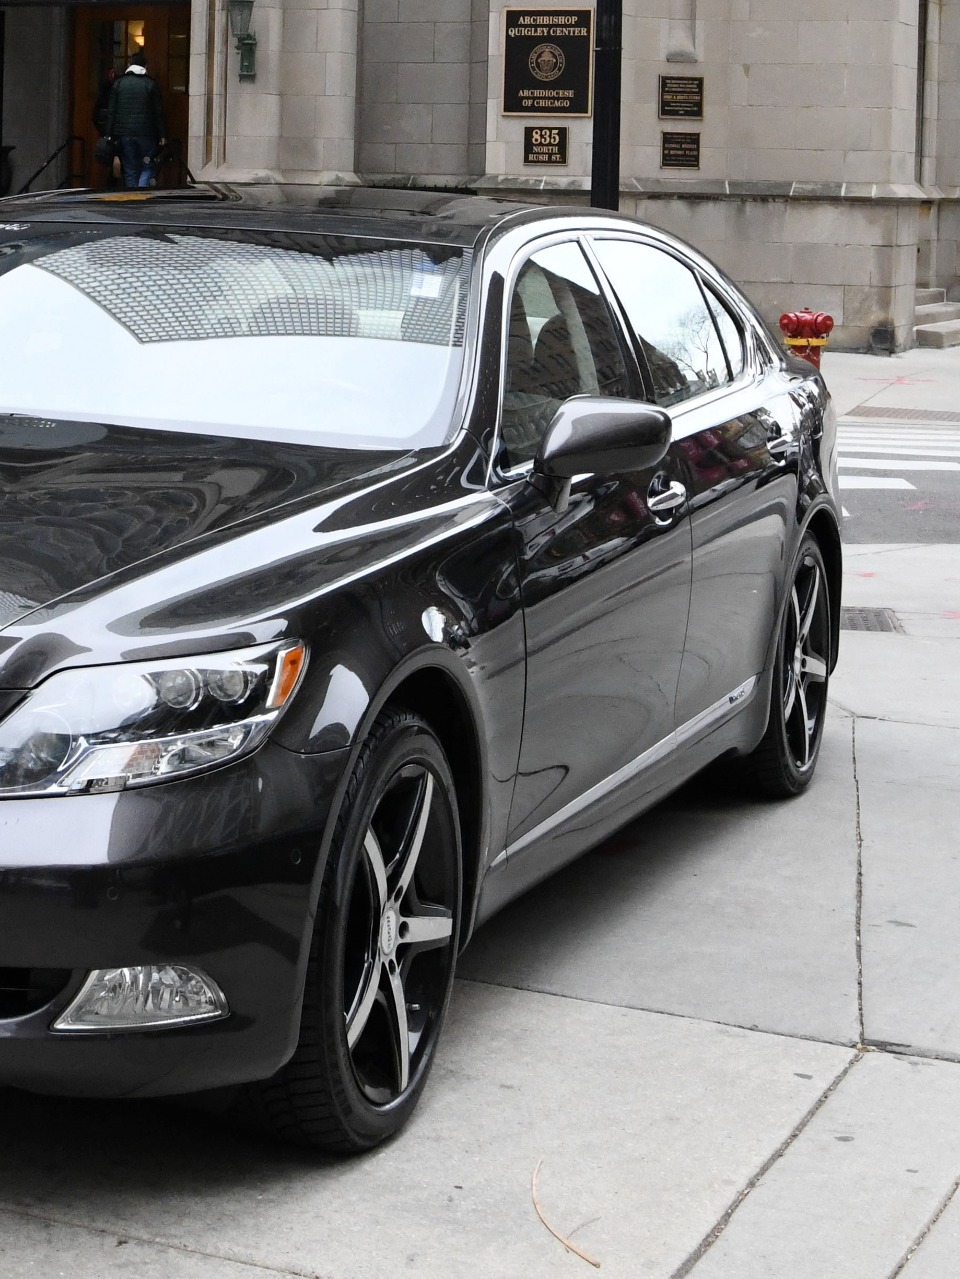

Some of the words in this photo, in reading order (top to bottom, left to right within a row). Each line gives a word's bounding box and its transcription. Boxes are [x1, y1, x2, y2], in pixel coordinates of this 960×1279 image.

[518, 16, 578, 25] ARCHBISHOP
[508, 27, 549, 37] QUIGLEY
[550, 27, 588, 36] CENTER
[518, 89, 574, 98] ARCHDIOCESE
[522, 99, 533, 107] OF
[534, 99, 570, 107] CHICAGO
[532, 129, 560, 145] 835
[532, 145, 559, 154] NORTH
[528, 153, 549, 161] RUSH
